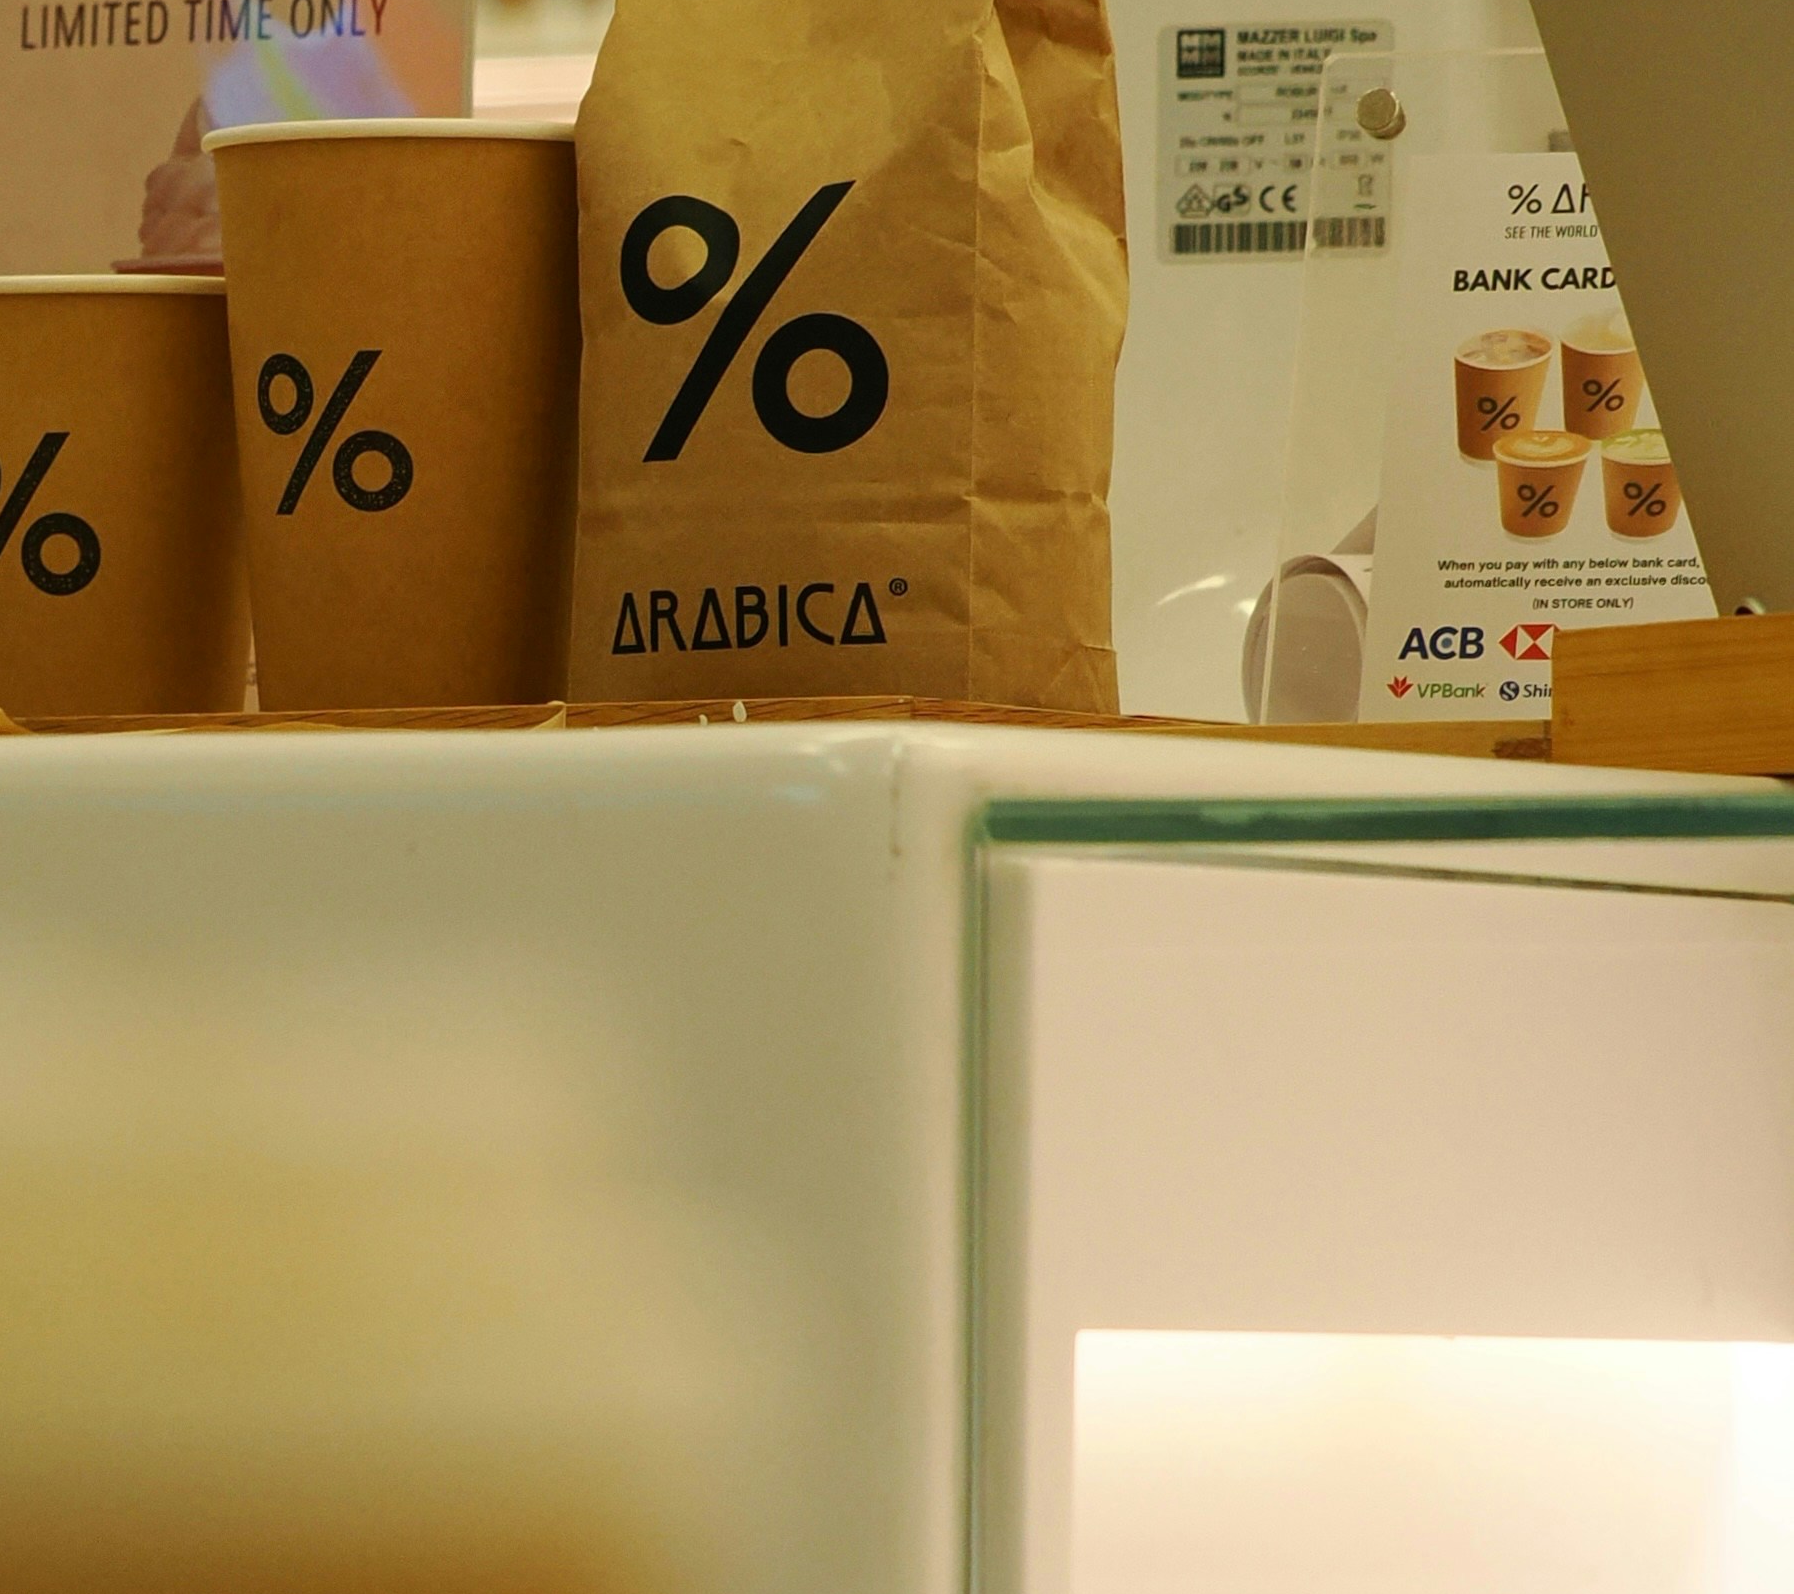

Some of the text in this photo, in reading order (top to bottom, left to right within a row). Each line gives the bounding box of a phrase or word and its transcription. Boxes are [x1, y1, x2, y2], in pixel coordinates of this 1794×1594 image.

[21, 0, 168, 49] LIMITED
[1237, 29, 1299, 45] MAZZER
[1505, 225, 1598, 239] SEE THE WORLD
[1453, 267, 1617, 291] BANK CARD
[1437, 557, 1700, 573] When you pay with any below bank card,
[1444, 577, 1531, 589] automatically
[1534, 577, 1583, 587] receive
[1586, 578, 1602, 587] an
[1605, 575, 1667, 587] exclusive
[1532, 597, 1634, 610] (IN STORE ONLY)
[1398, 625, 1485, 660] ACB
[1417, 683, 1486, 698] VPBank
